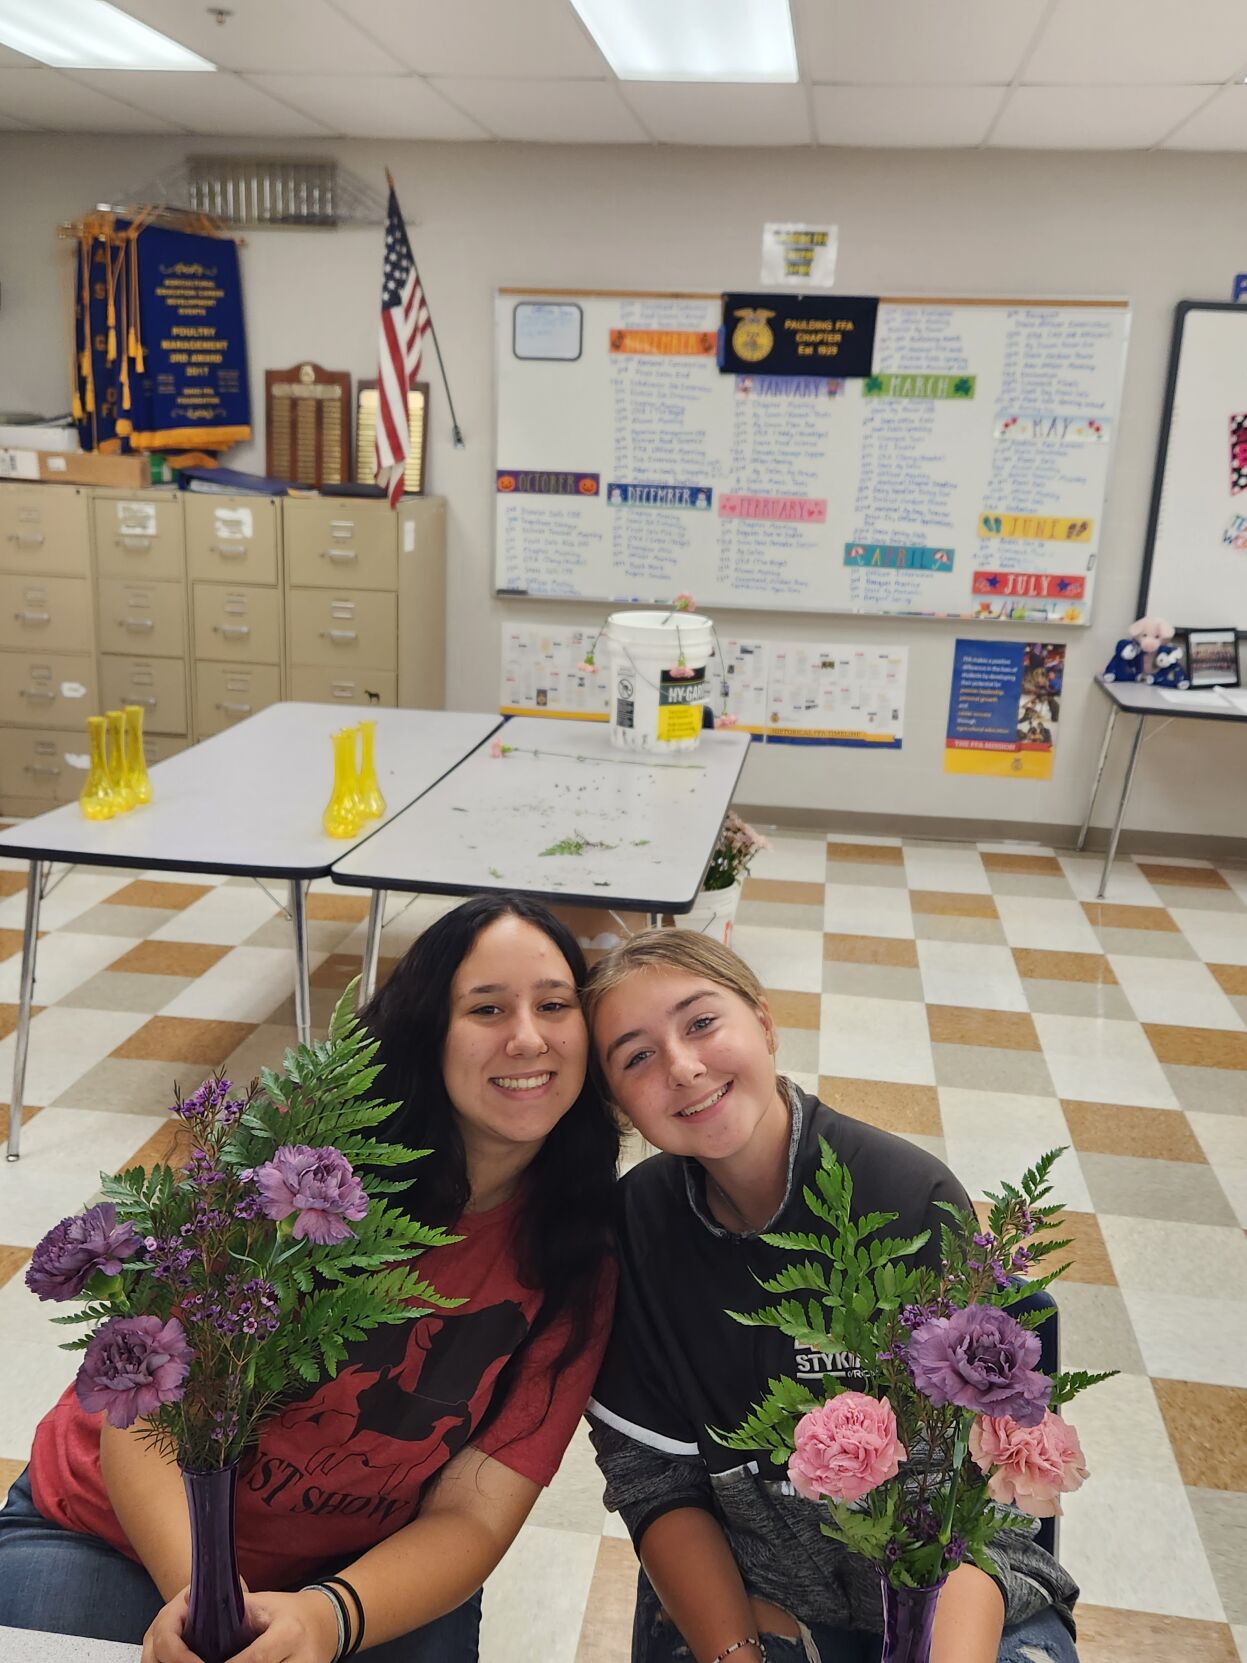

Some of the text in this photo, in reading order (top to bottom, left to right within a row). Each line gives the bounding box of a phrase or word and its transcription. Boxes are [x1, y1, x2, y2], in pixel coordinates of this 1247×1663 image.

[172, 326, 216, 337] POULTRY
[784, 319, 854, 331] PAULDING FFA
[161, 340, 228, 350] MANAGEMENT
[796, 332, 842, 343] CHAPTER
[756, 378, 820, 398] JANUARY
[889, 375, 949, 399] MARCH
[1032, 417, 1075, 439] MAY
[518, 473, 575, 493] OCTOBER
[627, 486, 691, 506] DECEMBER
[739, 498, 806, 519] FEBRUARY
[1008, 518, 1060, 539] JUNE
[871, 547, 926, 569] APRIL
[1004, 575, 1051, 596] JULY
[668, 683, 704, 703] MY-GAR
[289, 1485, 410, 1527] SHOW
